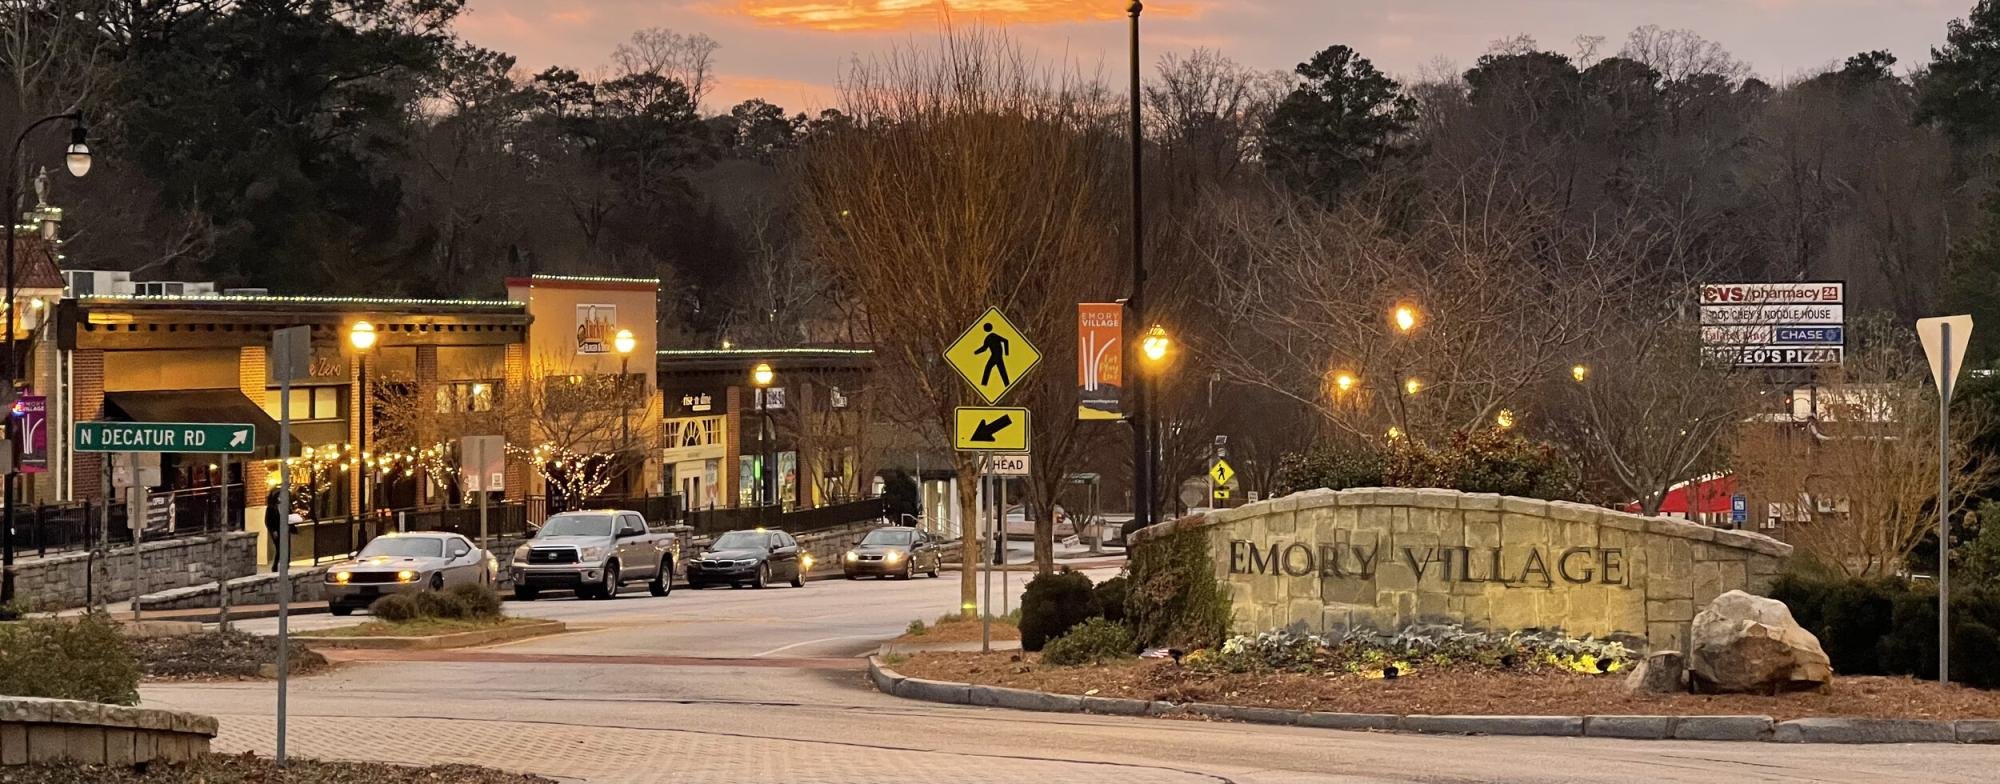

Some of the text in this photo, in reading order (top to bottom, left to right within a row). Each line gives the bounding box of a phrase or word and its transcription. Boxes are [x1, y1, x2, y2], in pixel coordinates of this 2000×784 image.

[1824, 287, 1836, 296] 24
[1081, 312, 1119, 320] EMORY
[1764, 310, 1799, 320] NOODLE
[1802, 309, 1831, 319] HOUSE
[1780, 330, 1823, 340] CHASE
[1786, 350, 1837, 363] PIZZA
[318, 357, 341, 376] Zero
[80, 428, 206, 446] N DECATUR RD
[1229, 540, 1623, 585] EMORY VILLAGE
